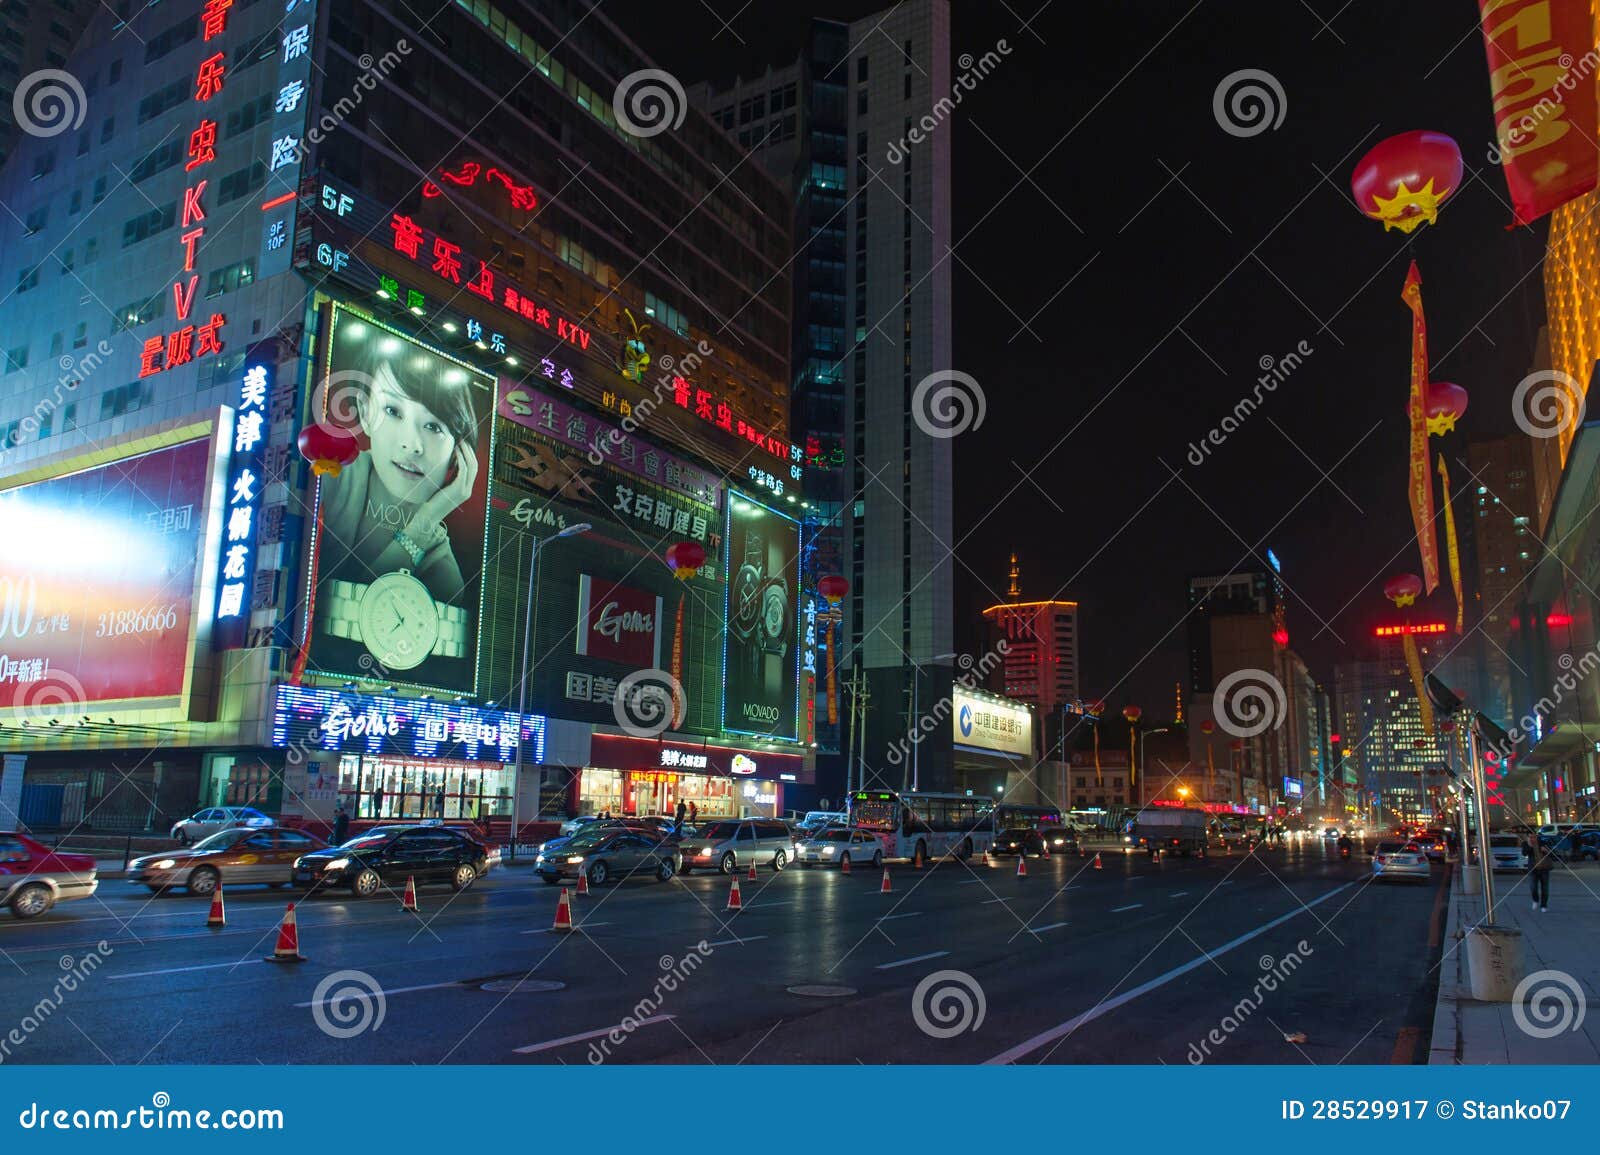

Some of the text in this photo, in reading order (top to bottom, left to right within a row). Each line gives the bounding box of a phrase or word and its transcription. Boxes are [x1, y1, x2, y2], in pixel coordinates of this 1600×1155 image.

[322, 184, 354, 217] 5F
[267, 236, 286, 250] 10F
[269, 220, 285, 236] 9F
[317, 242, 350, 273] 6F
[138, 313, 225, 379] 量贩式
[466, 319, 506, 355] 快乐
[557, 316, 591, 351] KTV
[541, 358, 575, 389] 安全
[672, 376, 733, 433] 音乐虫
[767, 437, 790, 461] KTV
[791, 444, 804, 463] 5F
[790, 464, 804, 481] 6F
[613, 484, 707, 541] 艾克斯健身
[95, 602, 178, 639] 31886666
[743, 703, 780, 721] MOVADO
[975, 711, 1023, 736] 中国建设银行
[424, 718, 520, 748] 国美电器
